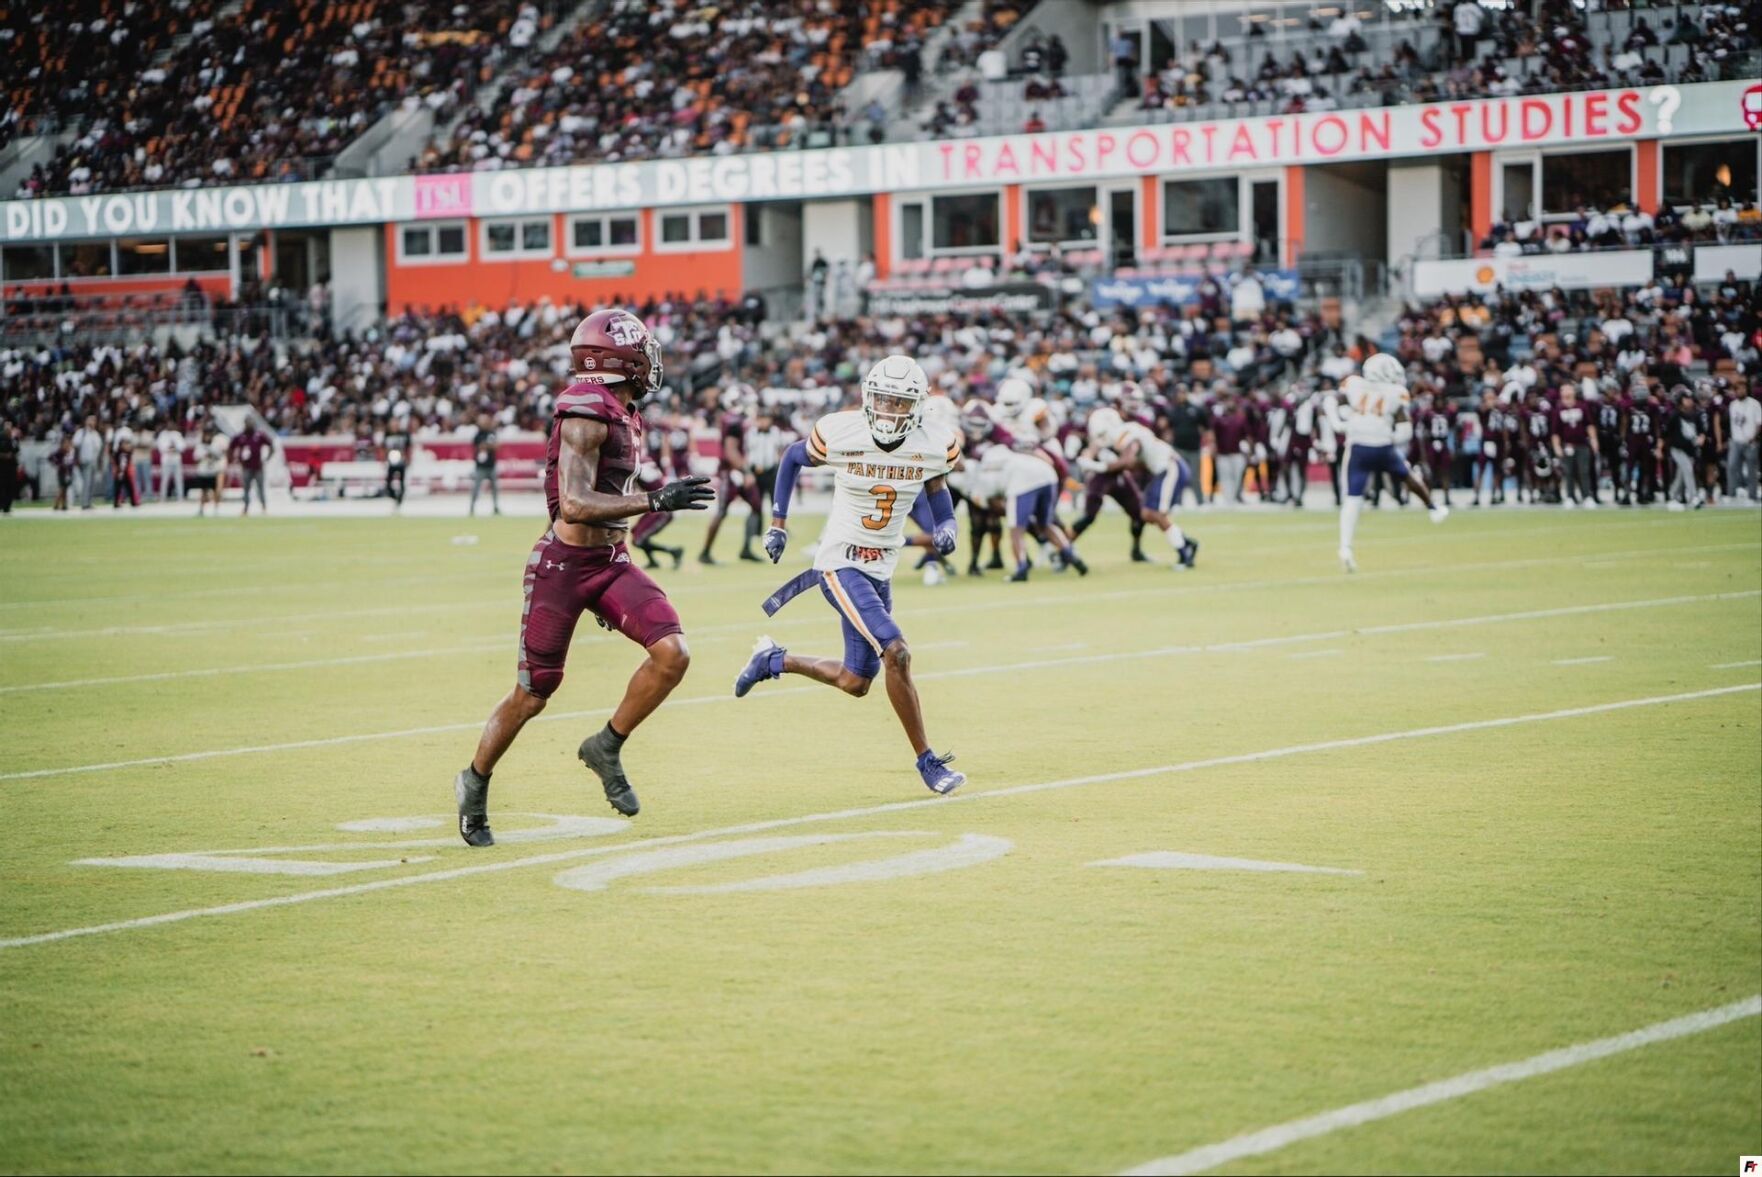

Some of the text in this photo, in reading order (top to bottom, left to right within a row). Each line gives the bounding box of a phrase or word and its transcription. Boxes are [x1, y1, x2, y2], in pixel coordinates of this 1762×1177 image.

[7, 207, 68, 240] DID
[81, 199, 158, 235] YOU
[173, 185, 291, 232] KNOW
[302, 177, 397, 223] THAT
[489, 164, 641, 213] OFFERS
[656, 149, 853, 200] DEGREES
[869, 144, 919, 188] IN
[939, 110, 1391, 181] TRANSPORTATION
[847, 462, 924, 481] PANTHERS
[861, 484, 898, 531] 3
